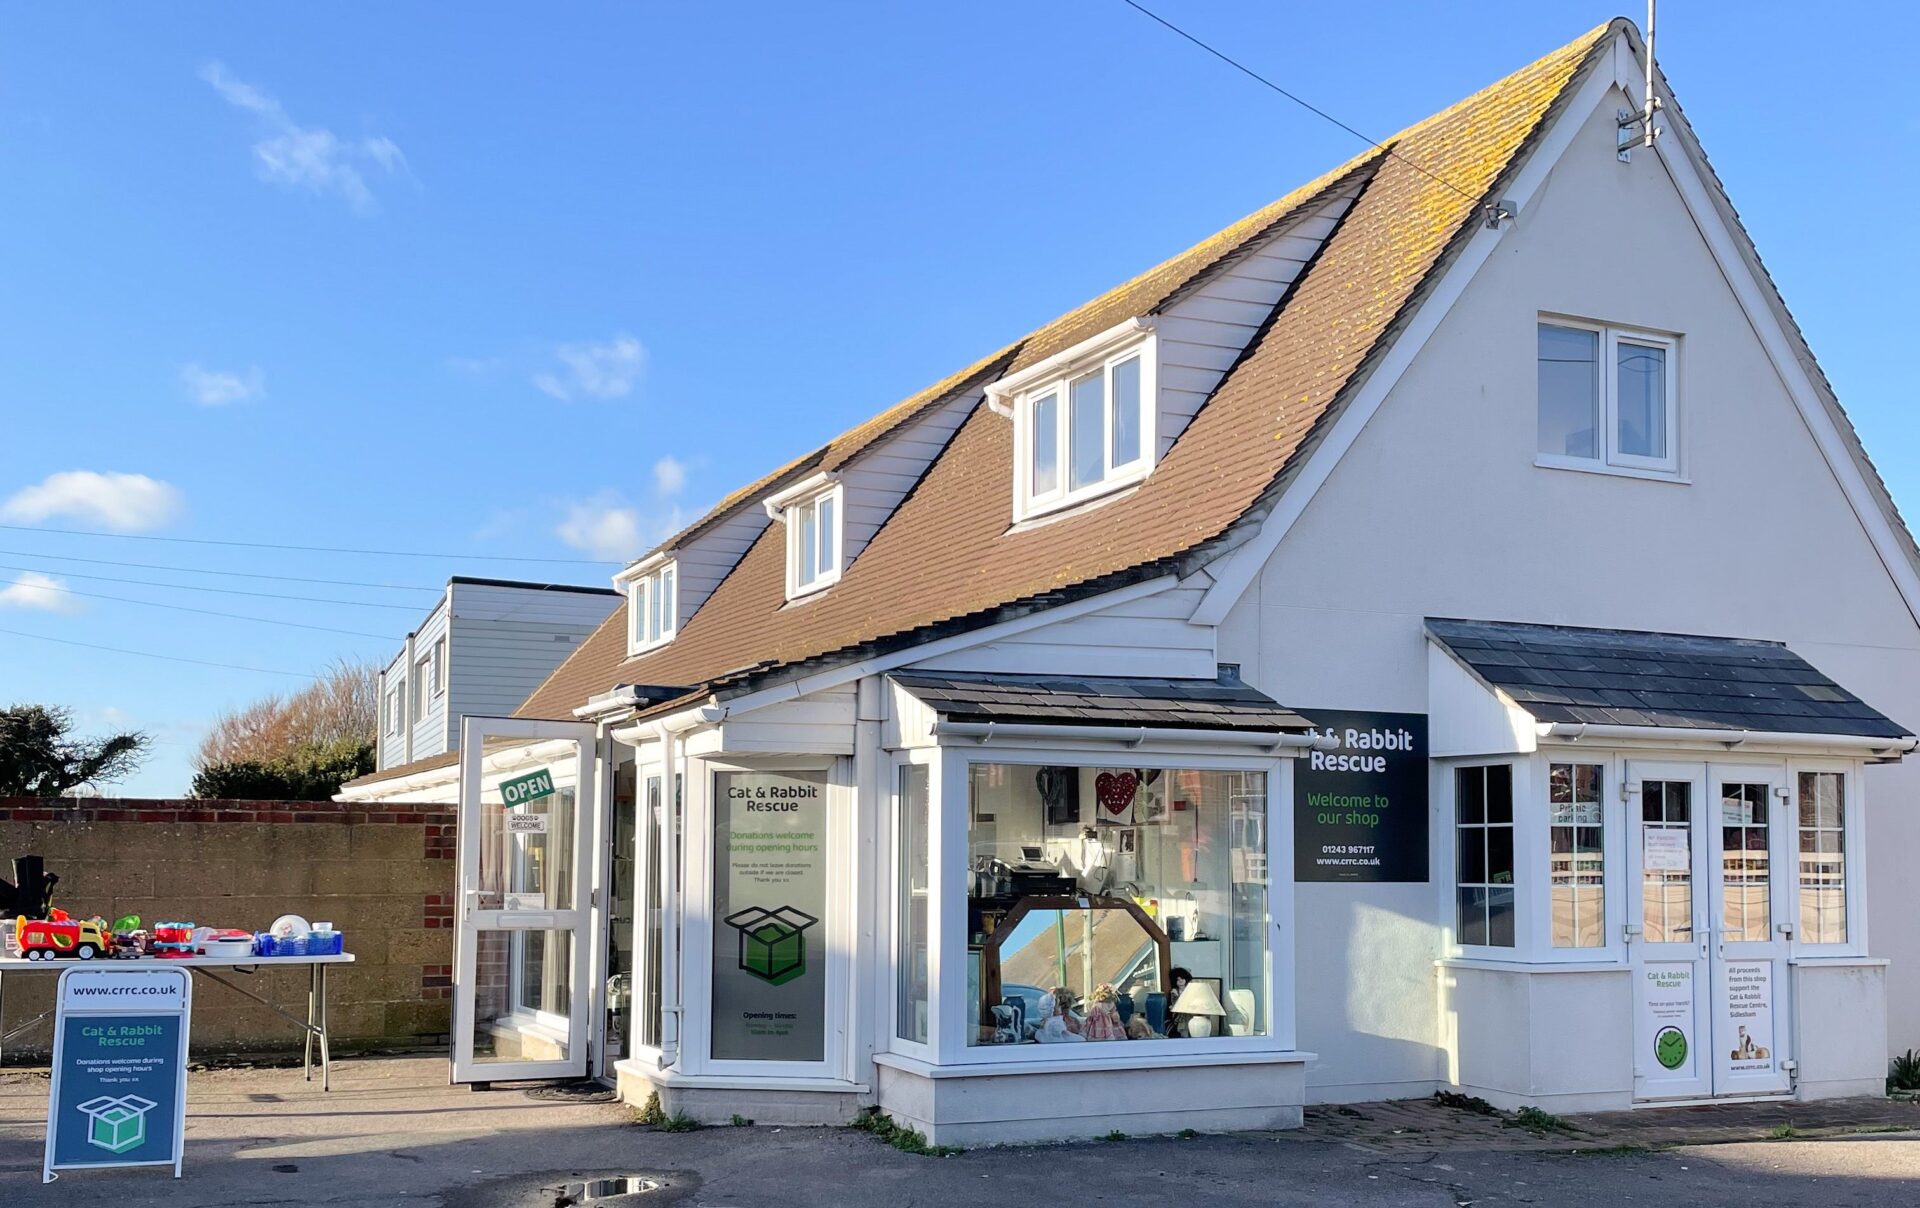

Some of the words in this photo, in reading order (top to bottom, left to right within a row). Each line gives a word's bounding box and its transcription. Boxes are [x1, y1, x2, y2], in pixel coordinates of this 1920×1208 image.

[1344, 727, 1413, 751] Rabbit
[1310, 750, 1386, 773] Rescue
[505, 774, 550, 802] OPEN
[727, 786, 752, 799] Cat
[755, 786, 766, 799] &
[770, 785, 818, 799] Rabbit
[1307, 792, 1371, 808] Welcome
[1374, 793, 1389, 808] to
[746, 800, 799, 812] Rescue
[1316, 812, 1342, 825] our
[1345, 810, 1379, 828] shop
[510, 821, 541, 829] WELCOME
[730, 831, 774, 840] Donations
[775, 831, 815, 840] welcome
[726, 843, 754, 854] during
[755, 844, 791, 854] opening
[792, 843, 818, 852] hours
[1322, 845, 1347, 854] 01243
[1347, 845, 1375, 854] 967117
[1316, 857, 1381, 866] www.crrc.co.uk
[1647, 972, 1659, 980] Cat
[1667, 970, 1690, 980] Rabbit
[1736, 967, 1760, 975] proceeds
[73, 985, 177, 996] www.crrc.co.uk
[742, 1011, 774, 1021] Opening
[774, 1011, 797, 1020] times:
[81, 1026, 105, 1037] Cat
[107, 1026, 117, 1036] &
[120, 1025, 163, 1036] Rabbit
[98, 1037, 145, 1047] Rescue
[142, 1057, 164, 1065] during
[86, 1066, 104, 1074] shop
[104, 1065, 132, 1074] opening
